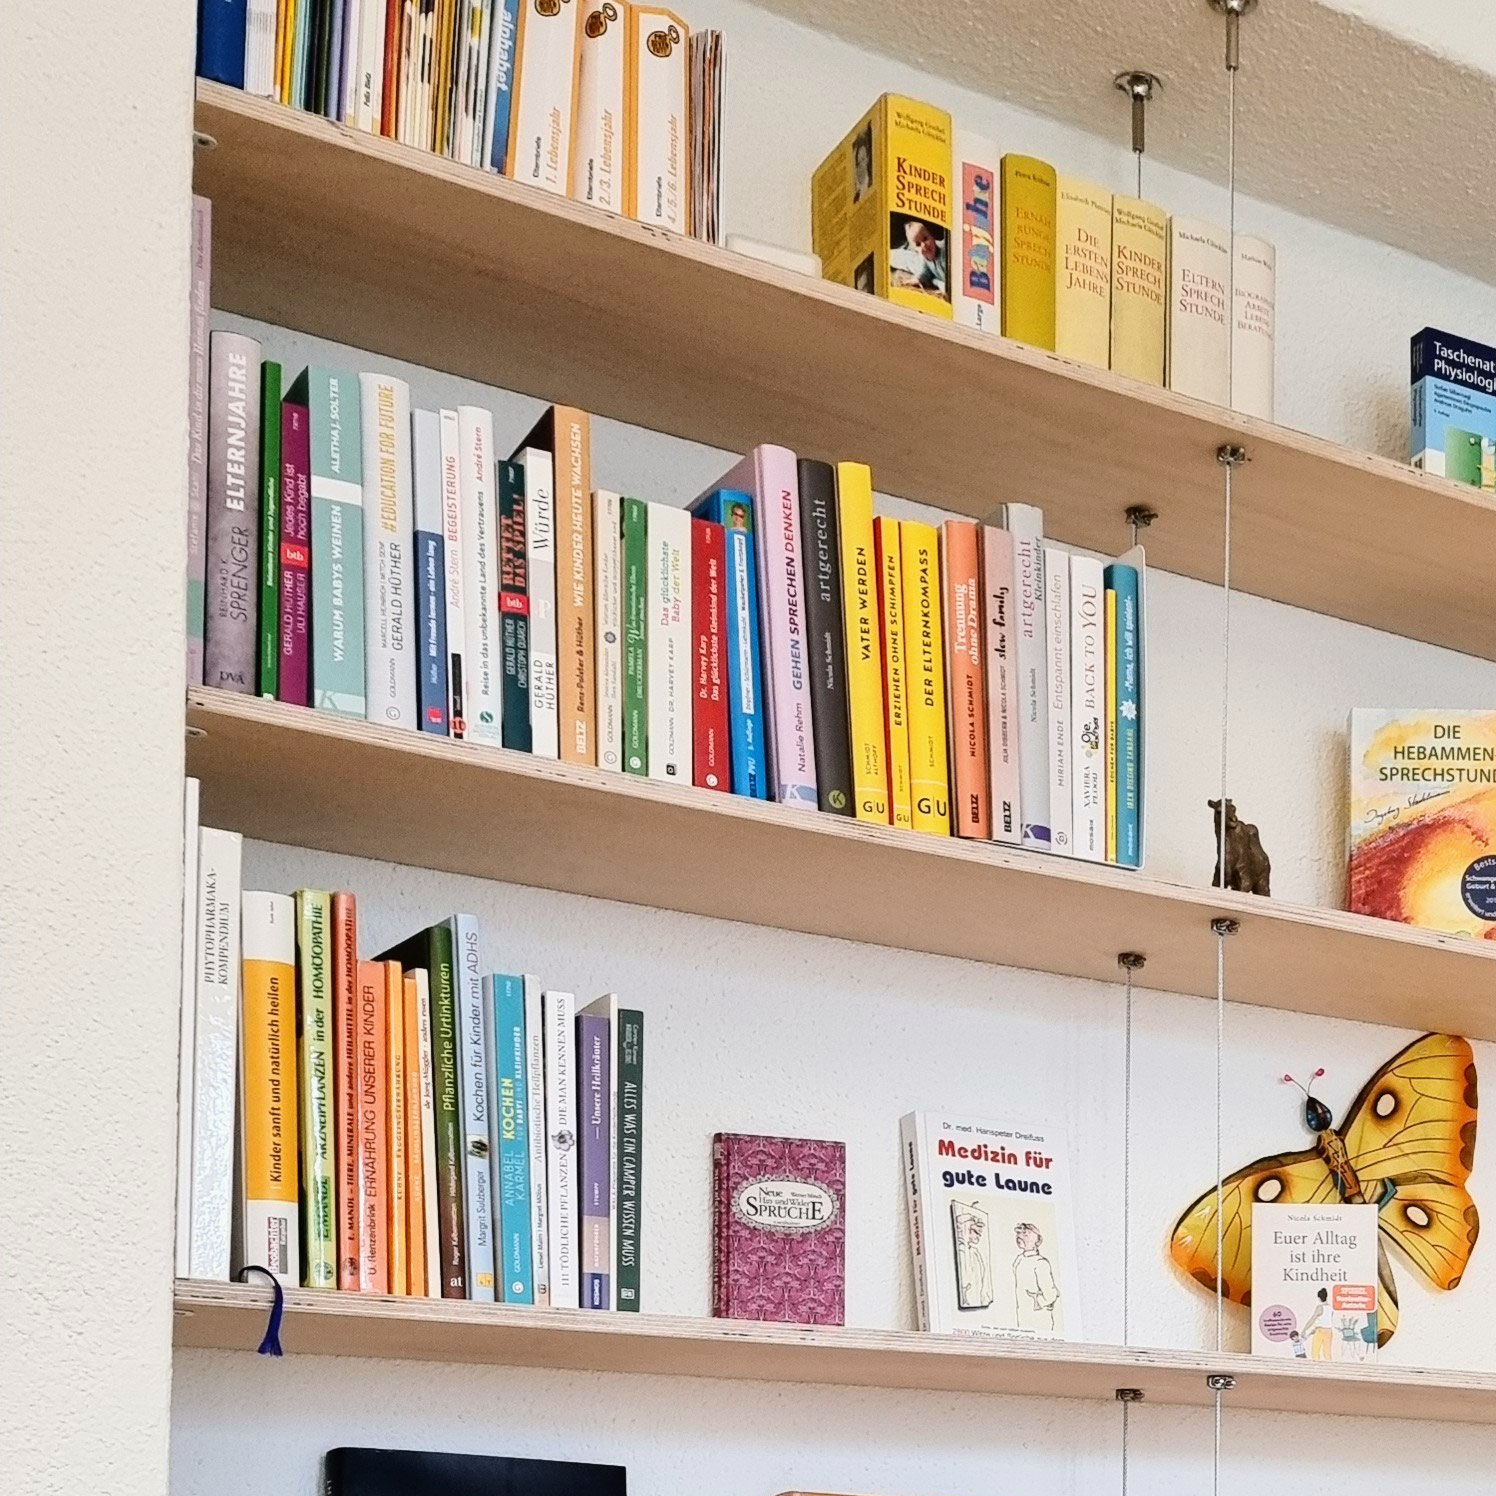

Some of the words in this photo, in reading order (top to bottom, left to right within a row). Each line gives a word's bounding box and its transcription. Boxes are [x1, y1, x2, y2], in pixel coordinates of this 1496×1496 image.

[895, 174, 946, 206] SPRECH
[896, 156, 946, 189] KINDER
[1117, 245, 1162, 273] KINDER
[1117, 261, 1161, 289] SPRECH
[1067, 273, 1104, 298] JAHRE
[1116, 277, 1162, 304] STUNDE
[1182, 284, 1224, 310] SPRECH
[1180, 299, 1224, 325] STUNDE
[226, 353, 246, 511] ELTERNJAHRE
[571, 423, 582, 485] WACHSEN
[297, 474, 308, 511] begabt
[572, 488, 582, 530] HEUTE
[330, 505, 342, 560] WEINEN
[513, 494, 524, 551] SPIEL!
[533, 489, 549, 549] Würde
[782, 490, 794, 552] DENKEN
[501, 515, 513, 585] RETTET
[572, 534, 584, 580] KINDER
[672, 549, 680, 572] Welt
[1034, 537, 1043, 601] Kleinkinder
[230, 527, 248, 622] SPRENGER
[332, 563, 343, 606] BABYS
[514, 558, 525, 587] DAS
[660, 541, 670, 604] glücklichste
[672, 576, 680, 593] der
[856, 547, 867, 610] WERDEN
[888, 555, 897, 625] SCHIMPFEN
[572, 583, 585, 608] WIE
[672, 597, 681, 622] Baby
[786, 557, 799, 635] SPRECHEN
[966, 578, 977, 627] Drama
[993, 587, 1009, 628] family
[333, 610, 345, 661] WARUM
[661, 608, 669, 626] Das
[954, 583, 968, 653] Trennung
[860, 617, 871, 660] VATER
[890, 630, 899, 663] OHNE
[968, 630, 978, 664] ohne
[994, 633, 1006, 660] slow
[534, 660, 543, 708] GERALD
[791, 639, 803, 690] GEHEN
[544, 662, 554, 710] HÜTHER
[893, 668, 902, 726] ERZIEHEN
[795, 703, 803, 732] Rehm
[1434, 725, 1461, 739] DIE
[796, 736, 806, 772] Natalie
[204, 868, 217, 983] PHYTOPHARMAKA-
[218, 902, 230, 985] KOMPENDIUM
[466, 932, 478, 974] ADHS
[469, 978, 479, 1000] mit
[363, 985, 374, 1036] KINDER
[469, 1005, 480, 1045] Kinder
[363, 1040, 376, 1105] UNSERER
[471, 1050, 482, 1067] für
[471, 1073, 484, 1122] Kochen
[501, 1078, 515, 1140] KOCHEN
[363, 1110, 377, 1197] ERNÄHRUNG
[938, 1139, 1018, 1165] Medizin
[1025, 1151, 1054, 1170] für
[476, 1171, 486, 1213] Sulzberger
[514, 1152, 525, 1200] KARMEL
[942, 1170, 987, 1188] gute
[995, 1172, 1053, 1195] Laune
[267, 1217, 278, 1274] Beobachter
[367, 1203, 376, 1262] Renzenbrink
[477, 1216, 487, 1246] Margrit
[1273, 1231, 1308, 1245] Euer
[1313, 1231, 1357, 1249] Alltag
[368, 1265, 376, 1275] U.
[1283, 1268, 1348, 1282] Kindheit
[1290, 1250, 1306, 1263] ist
[1312, 1249, 1341, 1263] ihre
